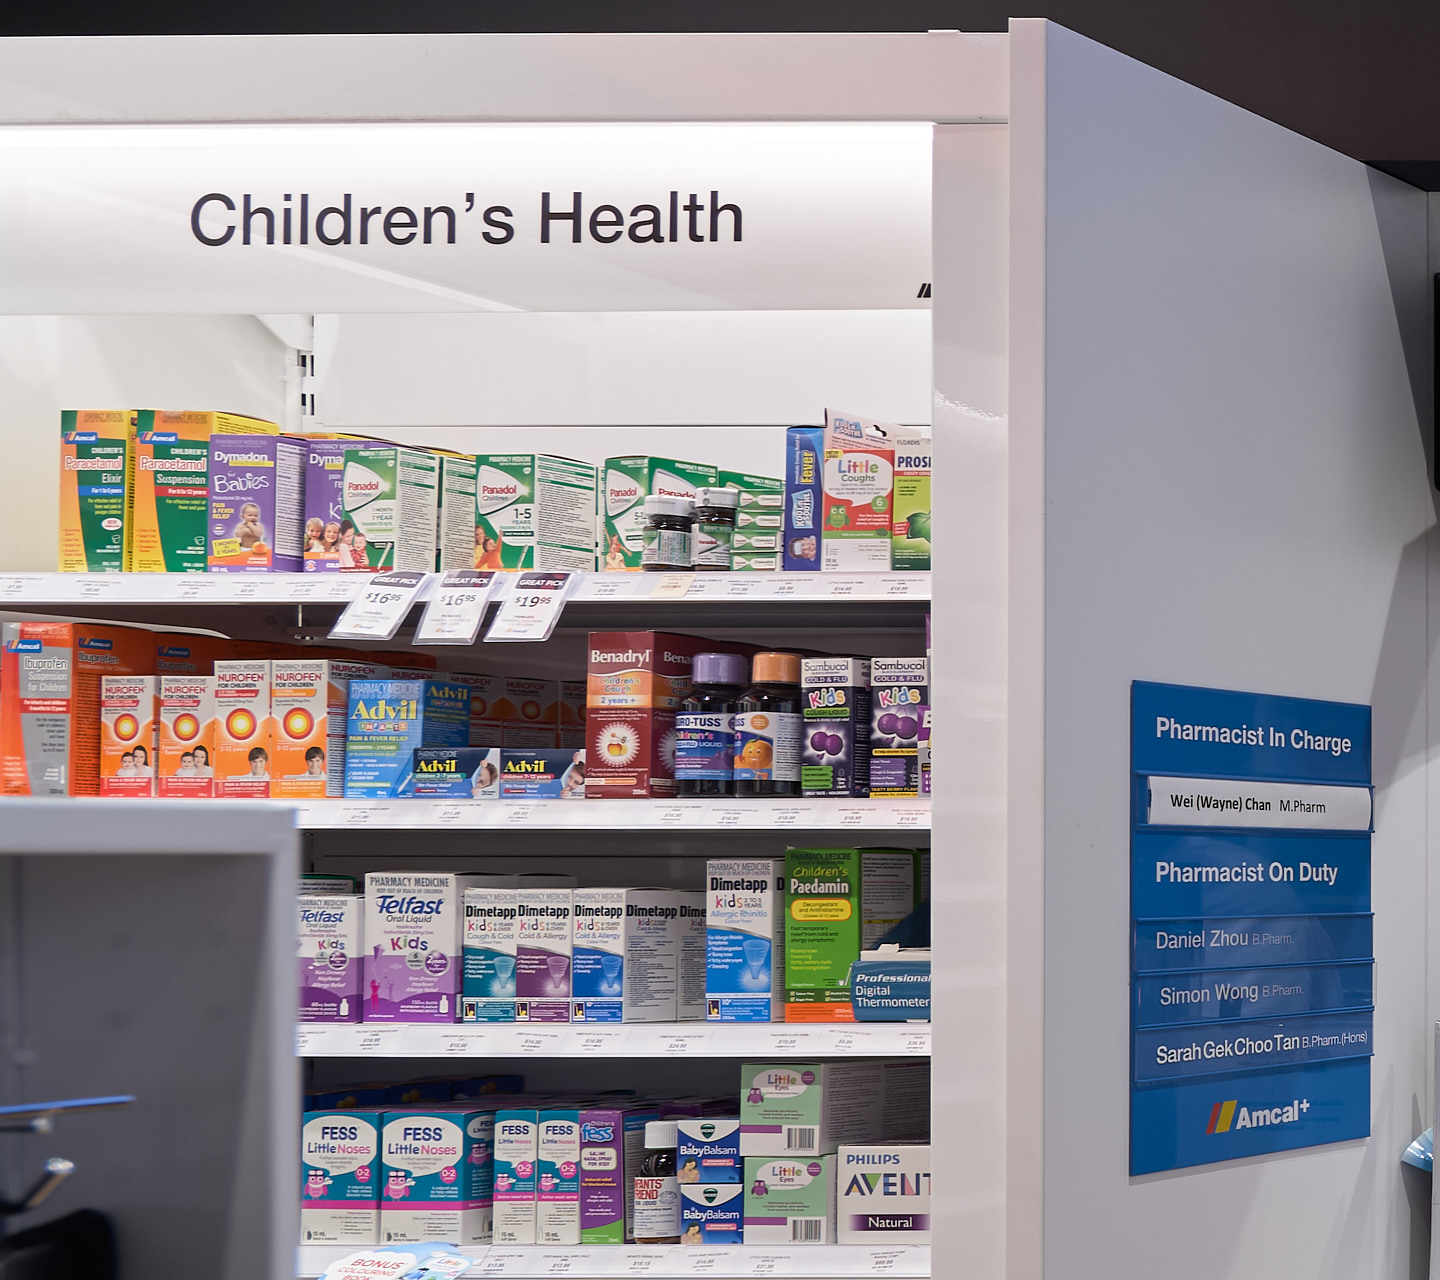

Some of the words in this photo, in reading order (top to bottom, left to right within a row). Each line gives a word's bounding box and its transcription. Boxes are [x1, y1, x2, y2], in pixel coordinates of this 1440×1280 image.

[190, 190, 517, 247] Children's
[539, 191, 743, 243] Health
[65, 455, 123, 471] Paracetamol
[214, 451, 268, 466] Dymadon
[482, 485, 517, 495] Panadol
[519, 579, 544, 587] GREAT
[545, 579, 564, 587] PICK
[591, 650, 650, 665] Benadryl
[804, 660, 849, 671] Sambucol
[217, 673, 265, 683] NUROFEN
[350, 700, 417, 720] Advil
[1156, 717, 1264, 747] Pharmacist
[1269, 727, 1285, 747] In
[1291, 729, 1351, 756] Charge
[1170, 794, 1193, 809] Wei
[1196, 794, 1243, 813] (Wayne)
[1245, 796, 1271, 811] Chan
[1279, 799, 1326, 814] M.Pharm
[1156, 861, 1264, 883] Pharmacist
[1269, 862, 1294, 882] On
[1299, 861, 1338, 886] Duty
[711, 877, 768, 893] Dimetapp
[790, 878, 849, 894] Paedamin
[376, 895, 445, 914] Telfast
[1156, 929, 1206, 950] Daniel
[1210, 929, 1248, 947] Zhou
[1252, 932, 1294, 946] B.Pharm.
[855, 986, 891, 997] Digital
[1160, 985, 1210, 1006] Simon
[1215, 983, 1258, 1004] Wong
[1262, 983, 1303, 999] B.Pharm.
[856, 998, 931, 1009] Thermometer
[1156, 1043, 1201, 1064] Sarah
[1203, 1041, 1233, 1060] Gek
[1235, 1037, 1273, 1056] Choo
[1274, 1033, 1300, 1053] Tan
[321, 1126, 358, 1141] FESS
[846, 1154, 900, 1165] PHILIPS
[868, 1217, 913, 1228] Natural
